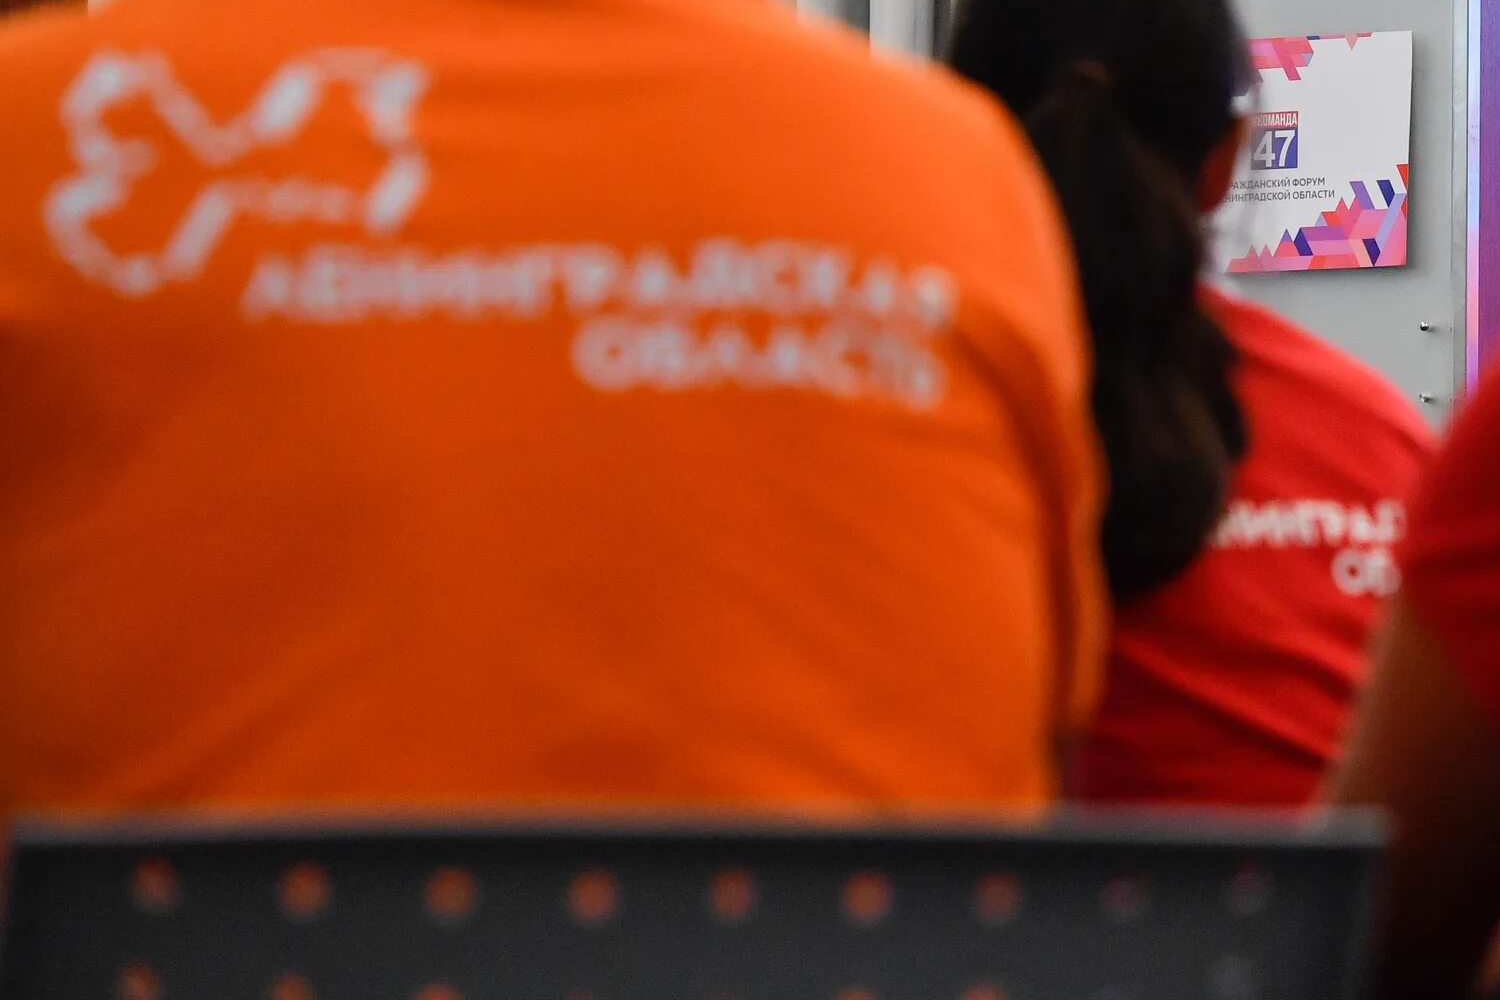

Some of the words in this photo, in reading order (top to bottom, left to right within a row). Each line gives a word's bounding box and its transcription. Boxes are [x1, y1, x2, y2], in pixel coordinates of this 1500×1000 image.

[1253, 129, 1296, 168] 47
[1292, 177, 1326, 188] ФОРУМ
[1292, 189, 1335, 200] ОБЛАСТИ
